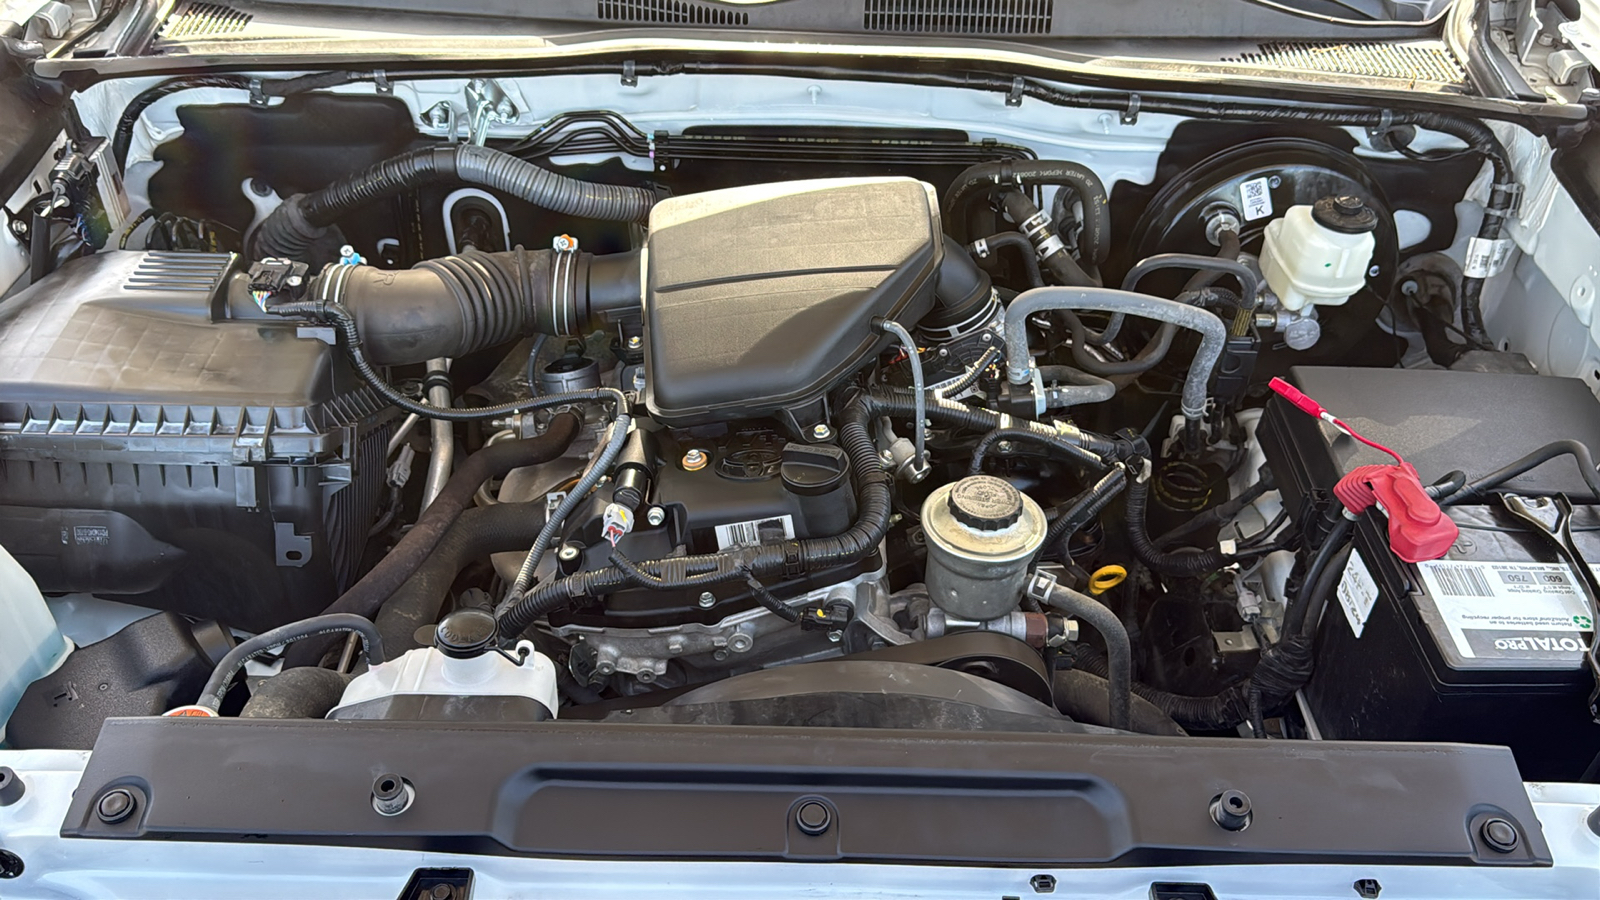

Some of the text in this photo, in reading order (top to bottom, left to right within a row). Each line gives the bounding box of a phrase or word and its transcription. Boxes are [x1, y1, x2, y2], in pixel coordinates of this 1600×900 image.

[1065, 169, 1085, 180] WATER
[1255, 205, 1265, 216] K
[1507, 574, 1529, 583] 750
[1543, 574, 1563, 583] 600
